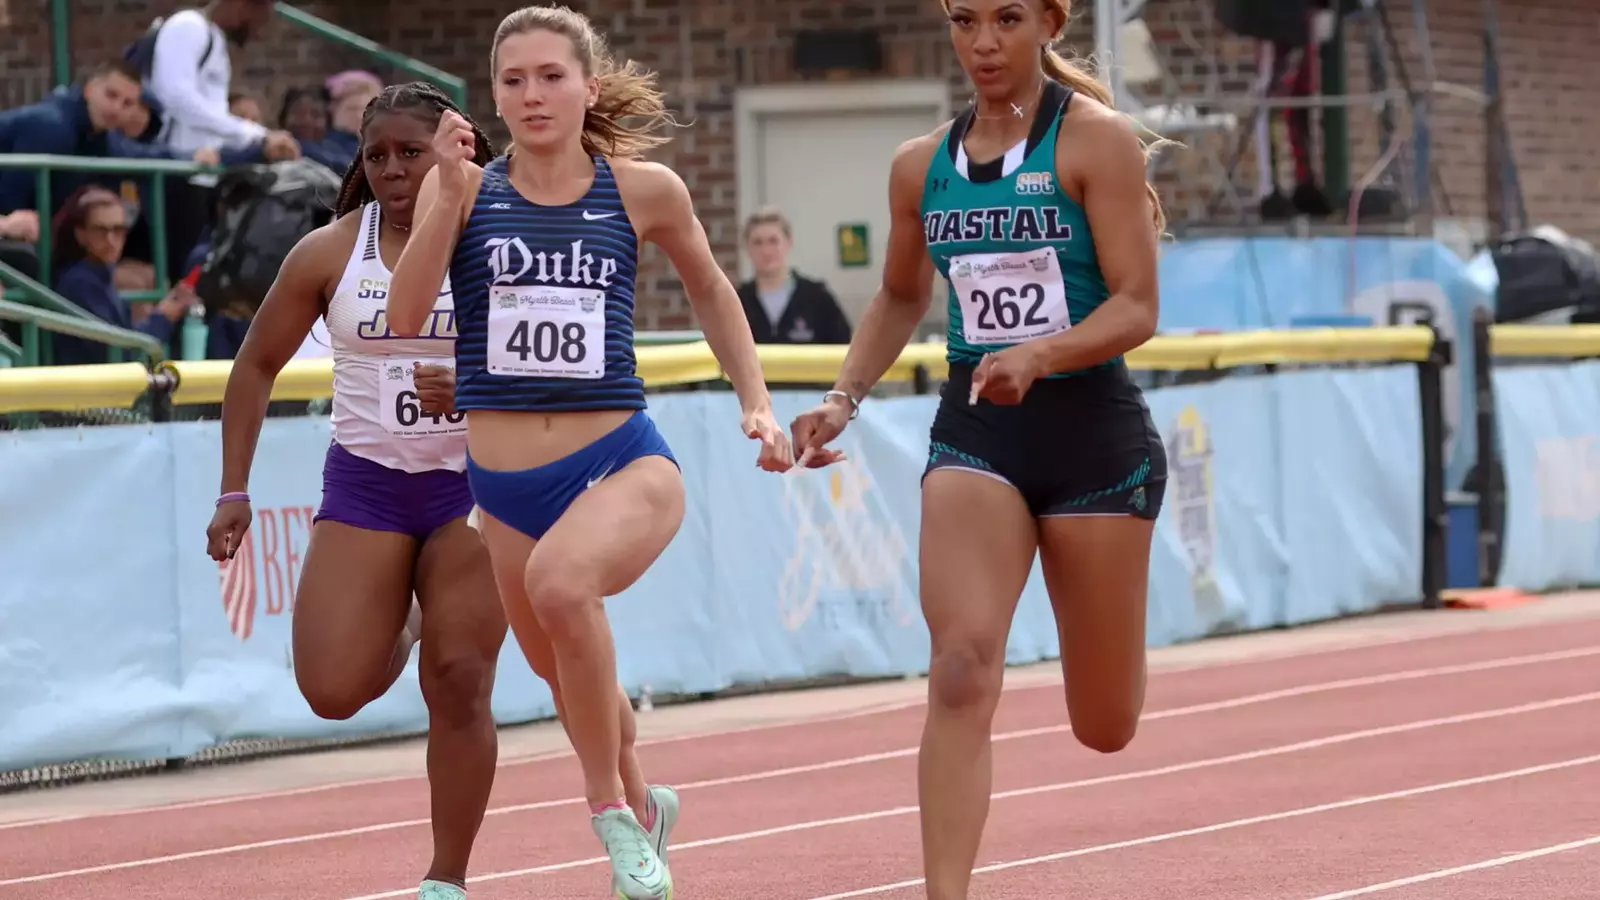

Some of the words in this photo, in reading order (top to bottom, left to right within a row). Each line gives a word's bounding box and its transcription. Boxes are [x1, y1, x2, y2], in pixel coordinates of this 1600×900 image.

[1016, 172, 1055, 195] SBC
[924, 206, 1072, 245] OASTAL
[484, 236, 618, 288] Duke
[357, 278, 388, 299] SB
[971, 282, 1049, 330] 262
[506, 320, 586, 363] 408
